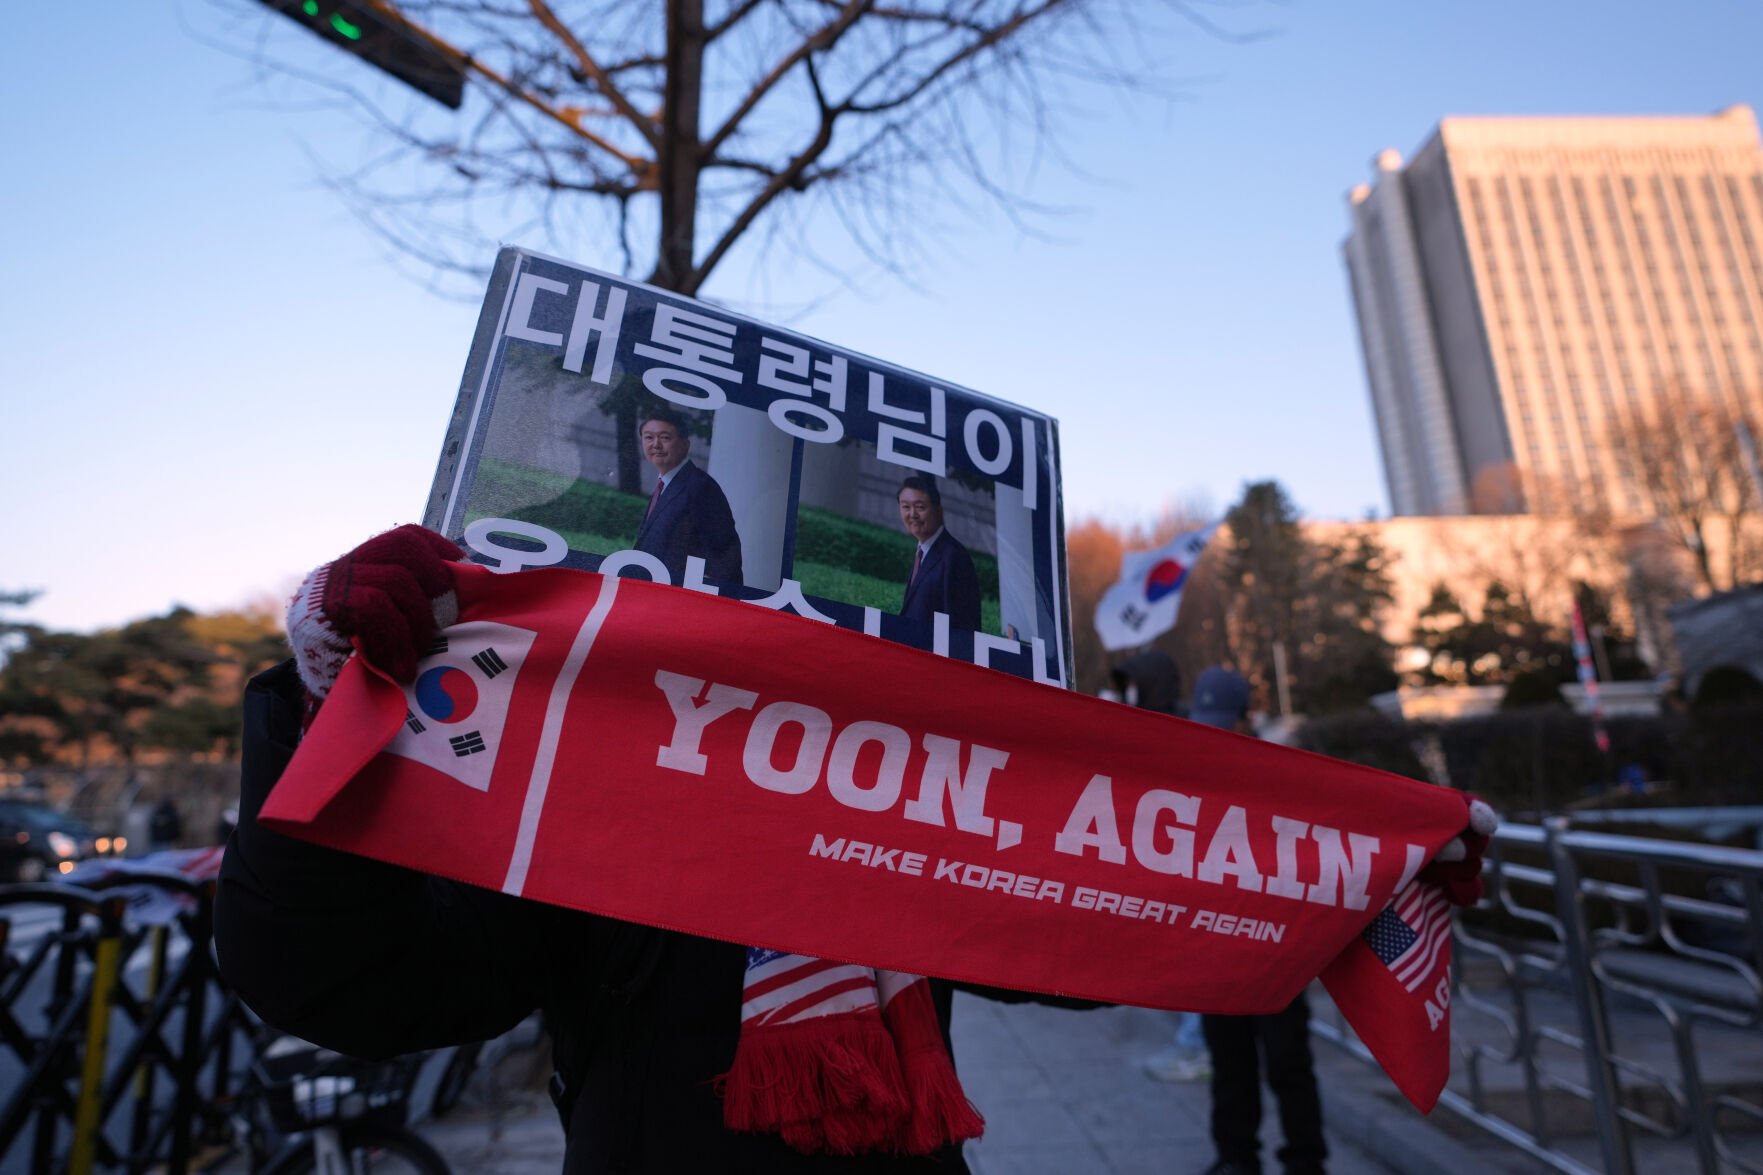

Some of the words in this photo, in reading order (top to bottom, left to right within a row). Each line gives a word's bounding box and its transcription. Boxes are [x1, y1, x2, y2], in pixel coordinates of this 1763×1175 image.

[504, 272, 1037, 510] 대통령님이
[654, 669, 1023, 851] YOON,
[1054, 774, 1380, 912] AGAIN
[808, 833, 928, 876] MAKE
[933, 858, 1065, 904] KOREA
[1071, 885, 1188, 925] GREAT
[1190, 910, 1286, 944] AGAIN
